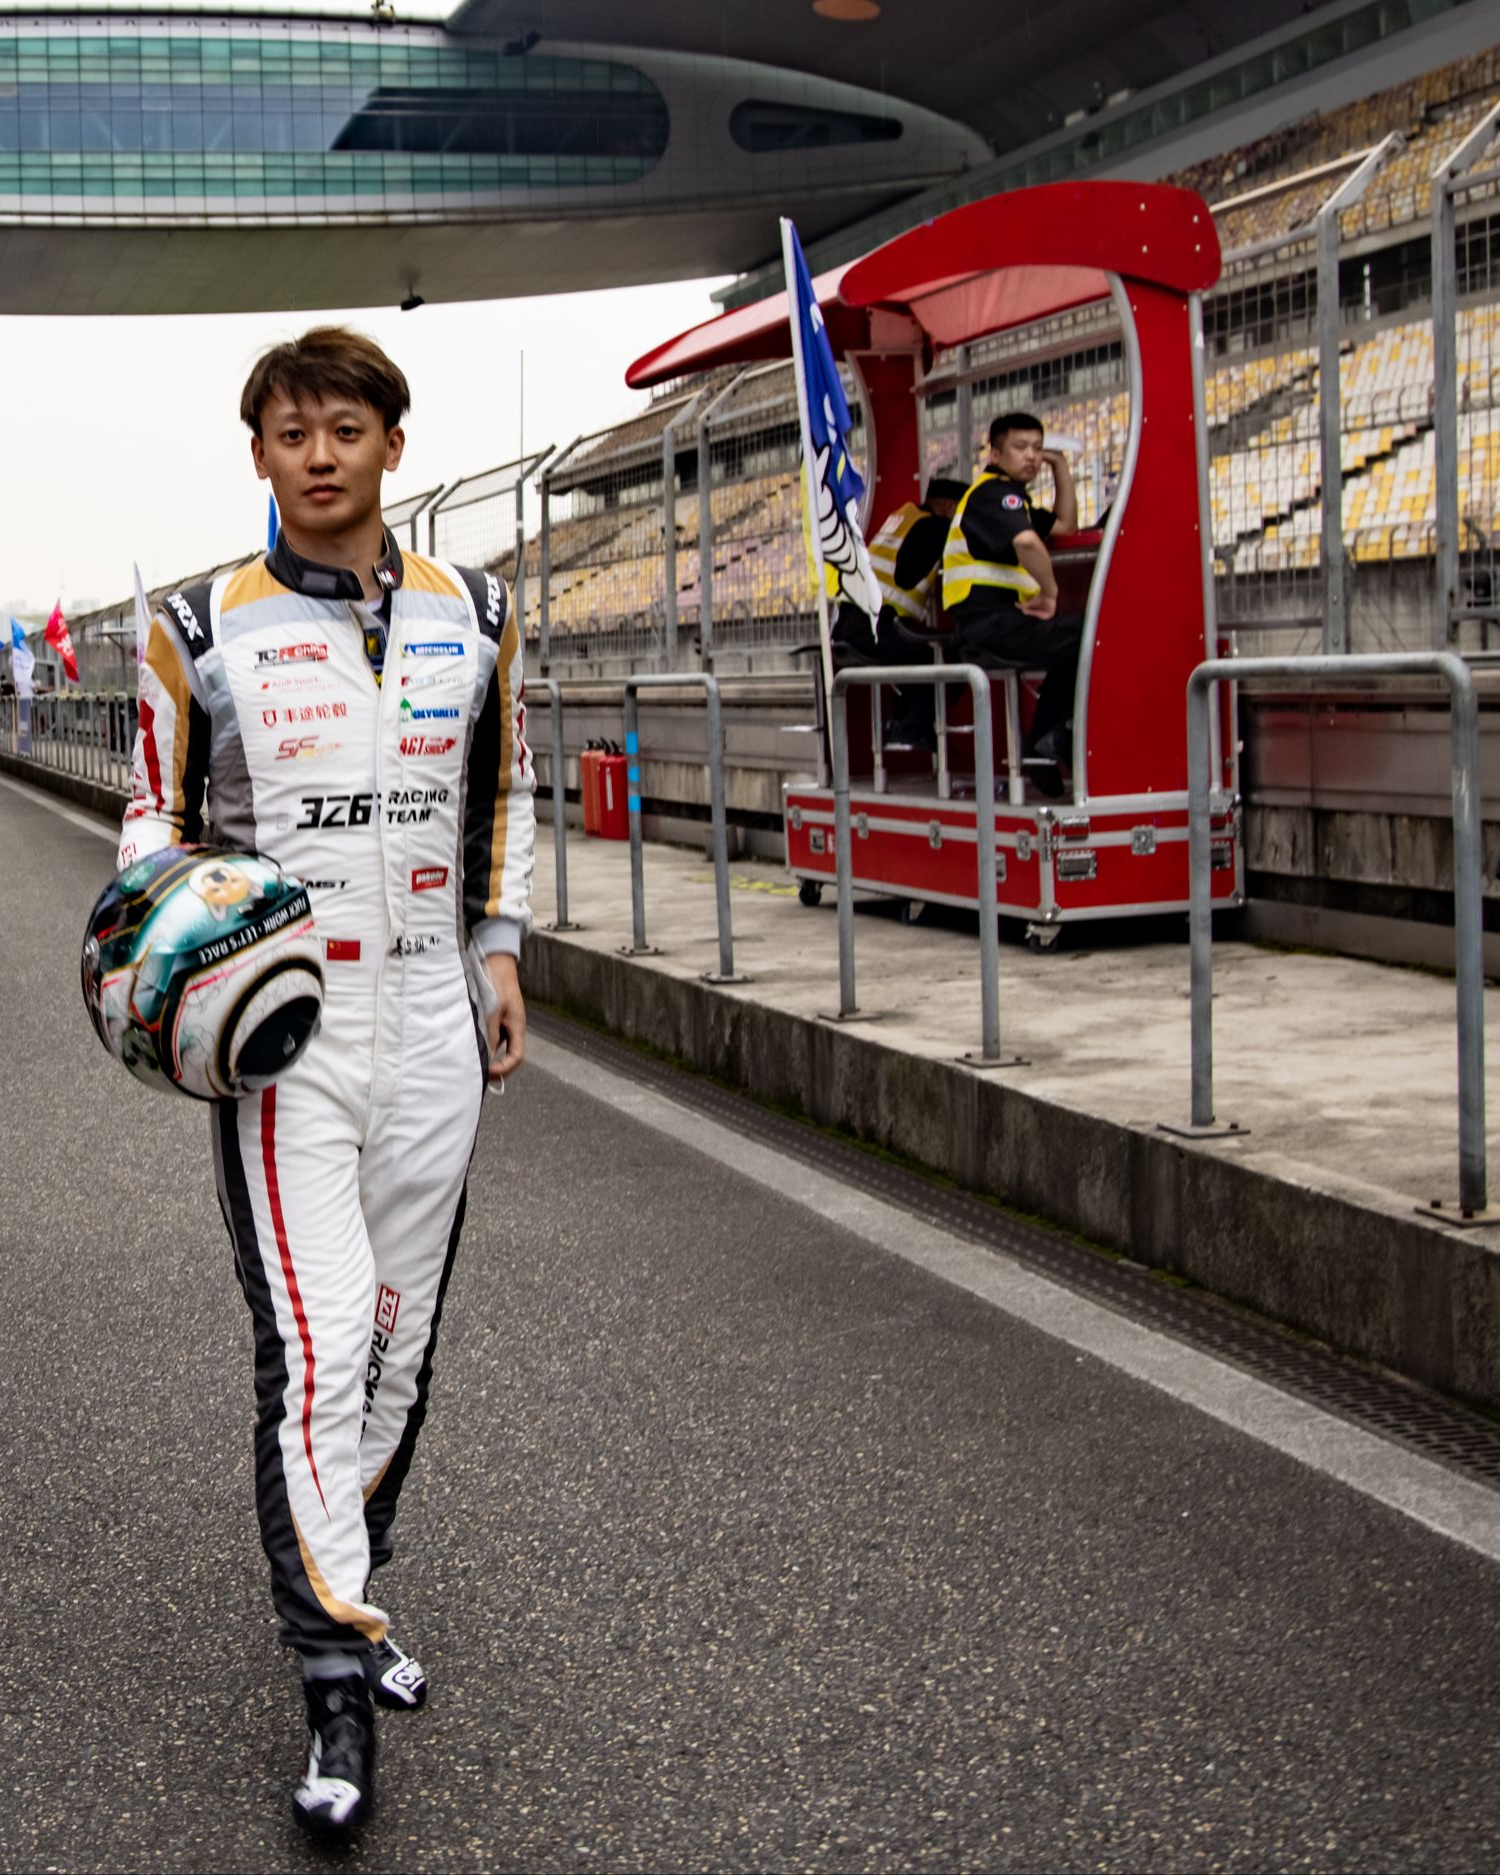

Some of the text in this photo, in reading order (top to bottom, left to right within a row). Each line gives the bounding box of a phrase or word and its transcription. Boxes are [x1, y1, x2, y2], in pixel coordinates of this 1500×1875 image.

[167, 592, 205, 641] HRX
[414, 646, 459, 655] MICHELIN
[388, 789, 449, 805] RACING
[297, 793, 381, 829] 326
[386, 809, 432, 824] TEAM
[263, 907, 290, 933] WORK
[198, 940, 230, 965] RACE
